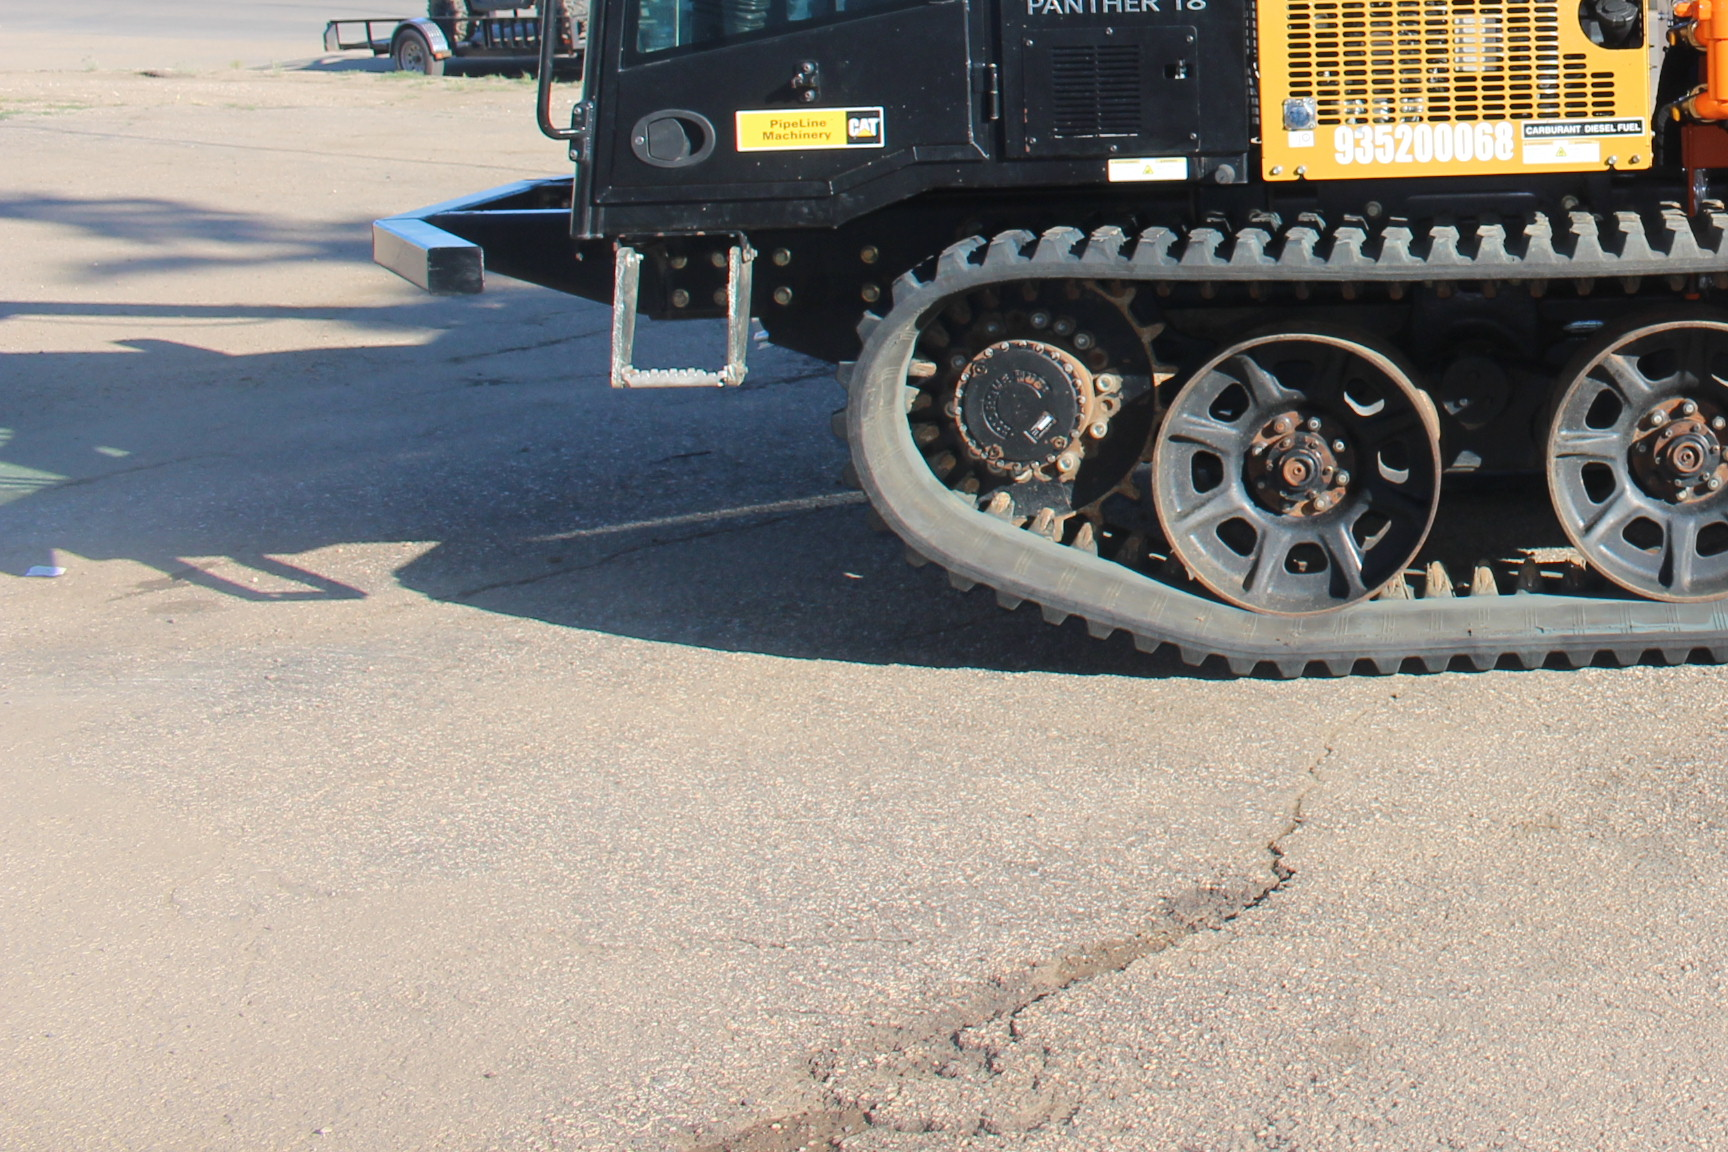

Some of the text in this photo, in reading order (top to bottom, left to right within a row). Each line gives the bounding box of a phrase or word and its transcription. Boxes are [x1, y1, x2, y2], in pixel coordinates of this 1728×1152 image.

[769, 118, 828, 129] PipeLine
[848, 117, 880, 137] CAT
[1525, 122, 1641, 135] CARBURANT DIESEL FUEL
[762, 130, 832, 141] Machinery
[1334, 121, 1515, 165] 935200068
